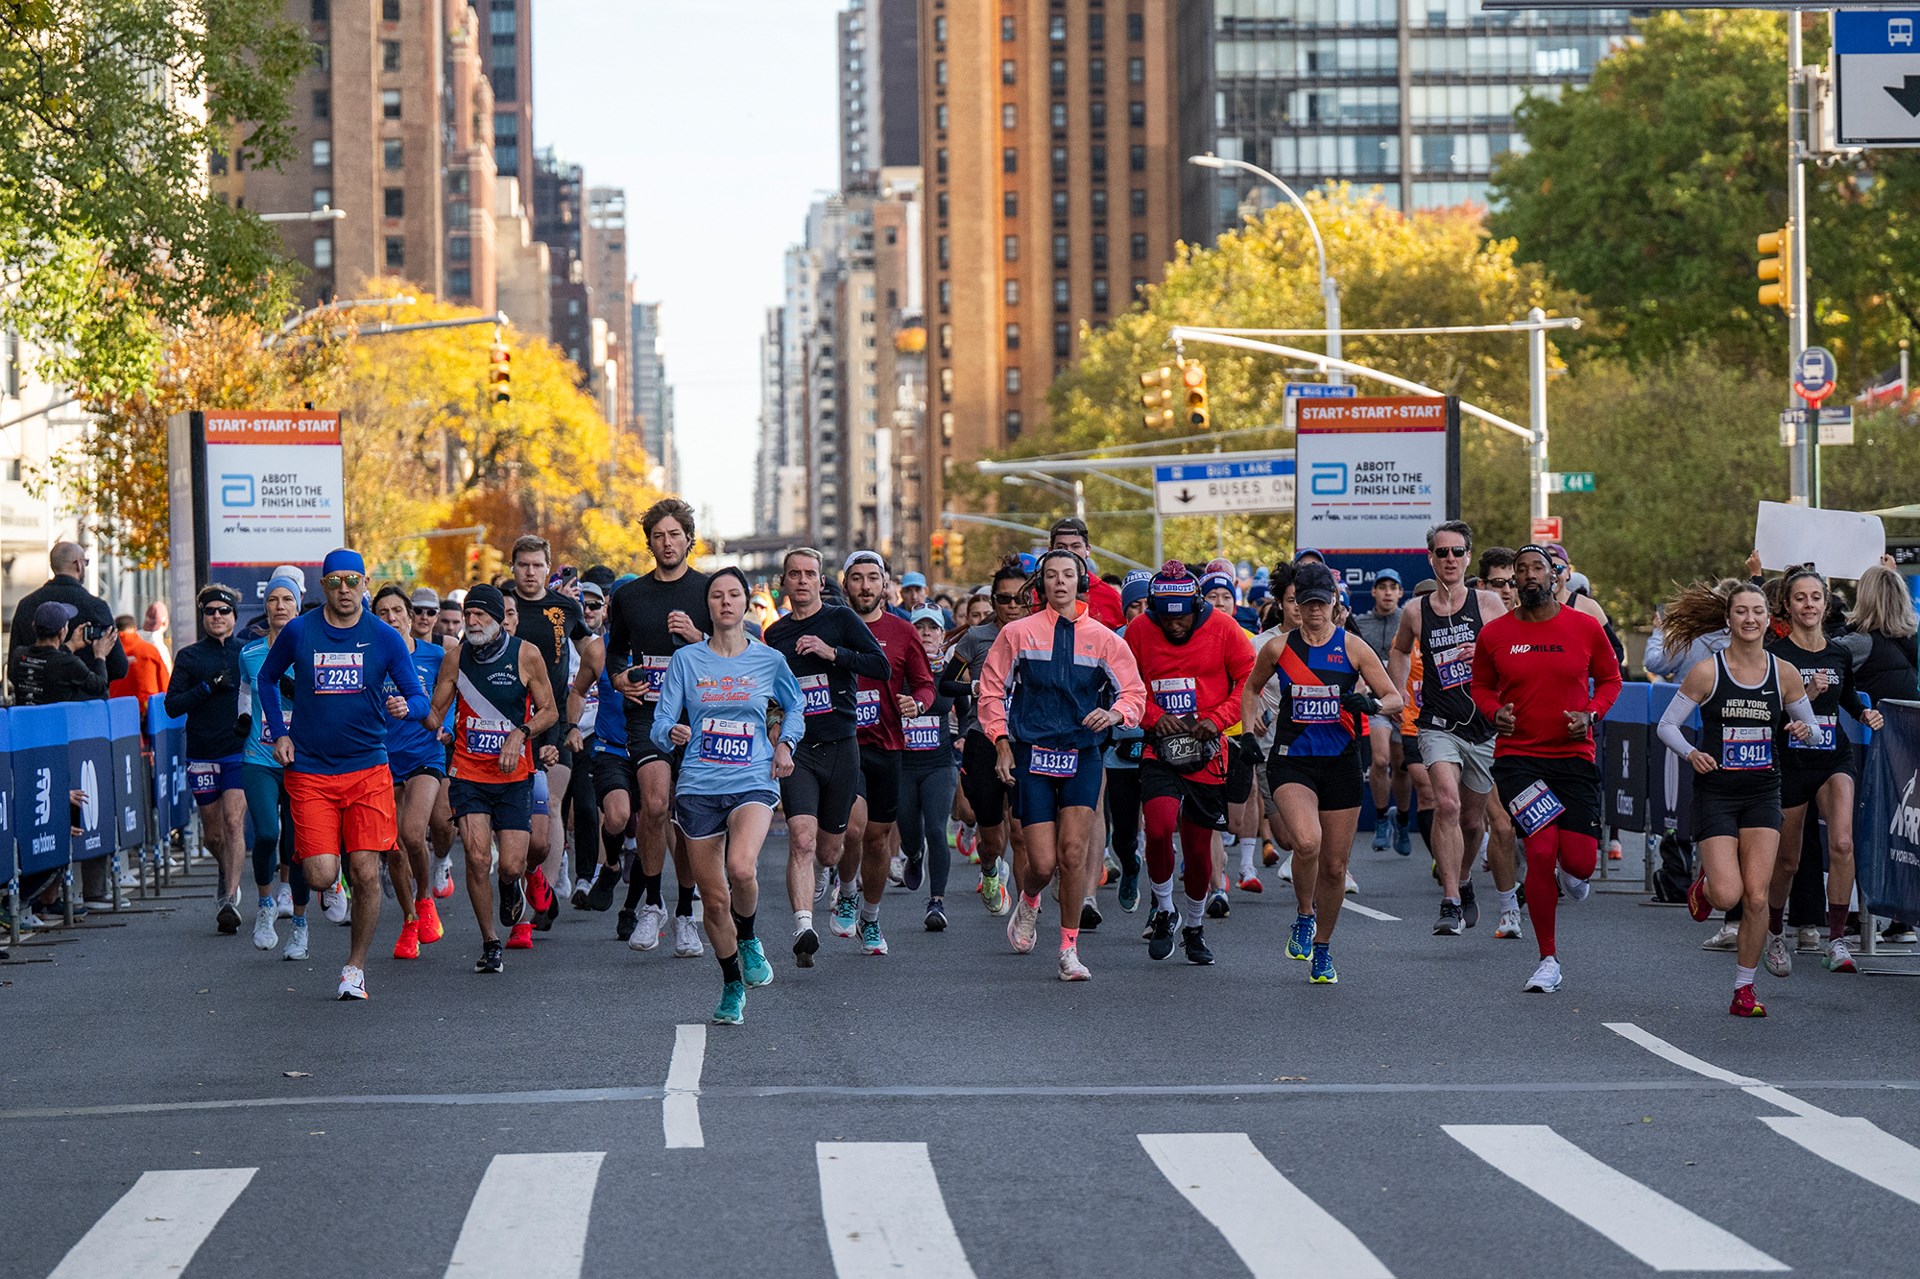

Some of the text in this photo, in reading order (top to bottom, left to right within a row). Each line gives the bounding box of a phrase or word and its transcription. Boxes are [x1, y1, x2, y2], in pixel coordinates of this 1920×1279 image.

[1302, 405, 1442, 420] START START START
[208, 419, 337, 433] START START START
[1206, 461, 1273, 478] BUS LANE
[1355, 461, 1396, 472] ABBOTT
[261, 474, 298, 484] ABBOTT
[1354, 472, 1422, 483] DASH TO THE
[1568, 475, 1584, 491] 44
[261, 486, 322, 496] DASH TO THE
[1208, 480, 1262, 497] BUSES
[1354, 484, 1431, 495] FINISH LINE 5K
[261, 498, 331, 508] FINISH LINE 5K
[1161, 583, 1190, 592] ABBOTT
[1431, 622, 1470, 638] NEW YORK
[1428, 630, 1476, 648] HARRIERS
[1327, 653, 1344, 664] NYC
[328, 669, 359, 685] 2243
[487, 671, 517, 681] CENTRAL PARK
[1800, 667, 1816, 676] NEW
[1165, 693, 1192, 709] 1016
[1303, 700, 1339, 715] 12100
[1726, 699, 1769, 710] NEW YORK
[1721, 707, 1772, 721] HARRIERS
[478, 733, 506, 749] 2730
[910, 730, 938, 744] 10116
[714, 737, 749, 756] 4059
[1740, 745, 1767, 762] 9411
[1041, 753, 1076, 769] 13137
[197, 774, 215, 787] 951
[1525, 794, 1558, 824] 11401
